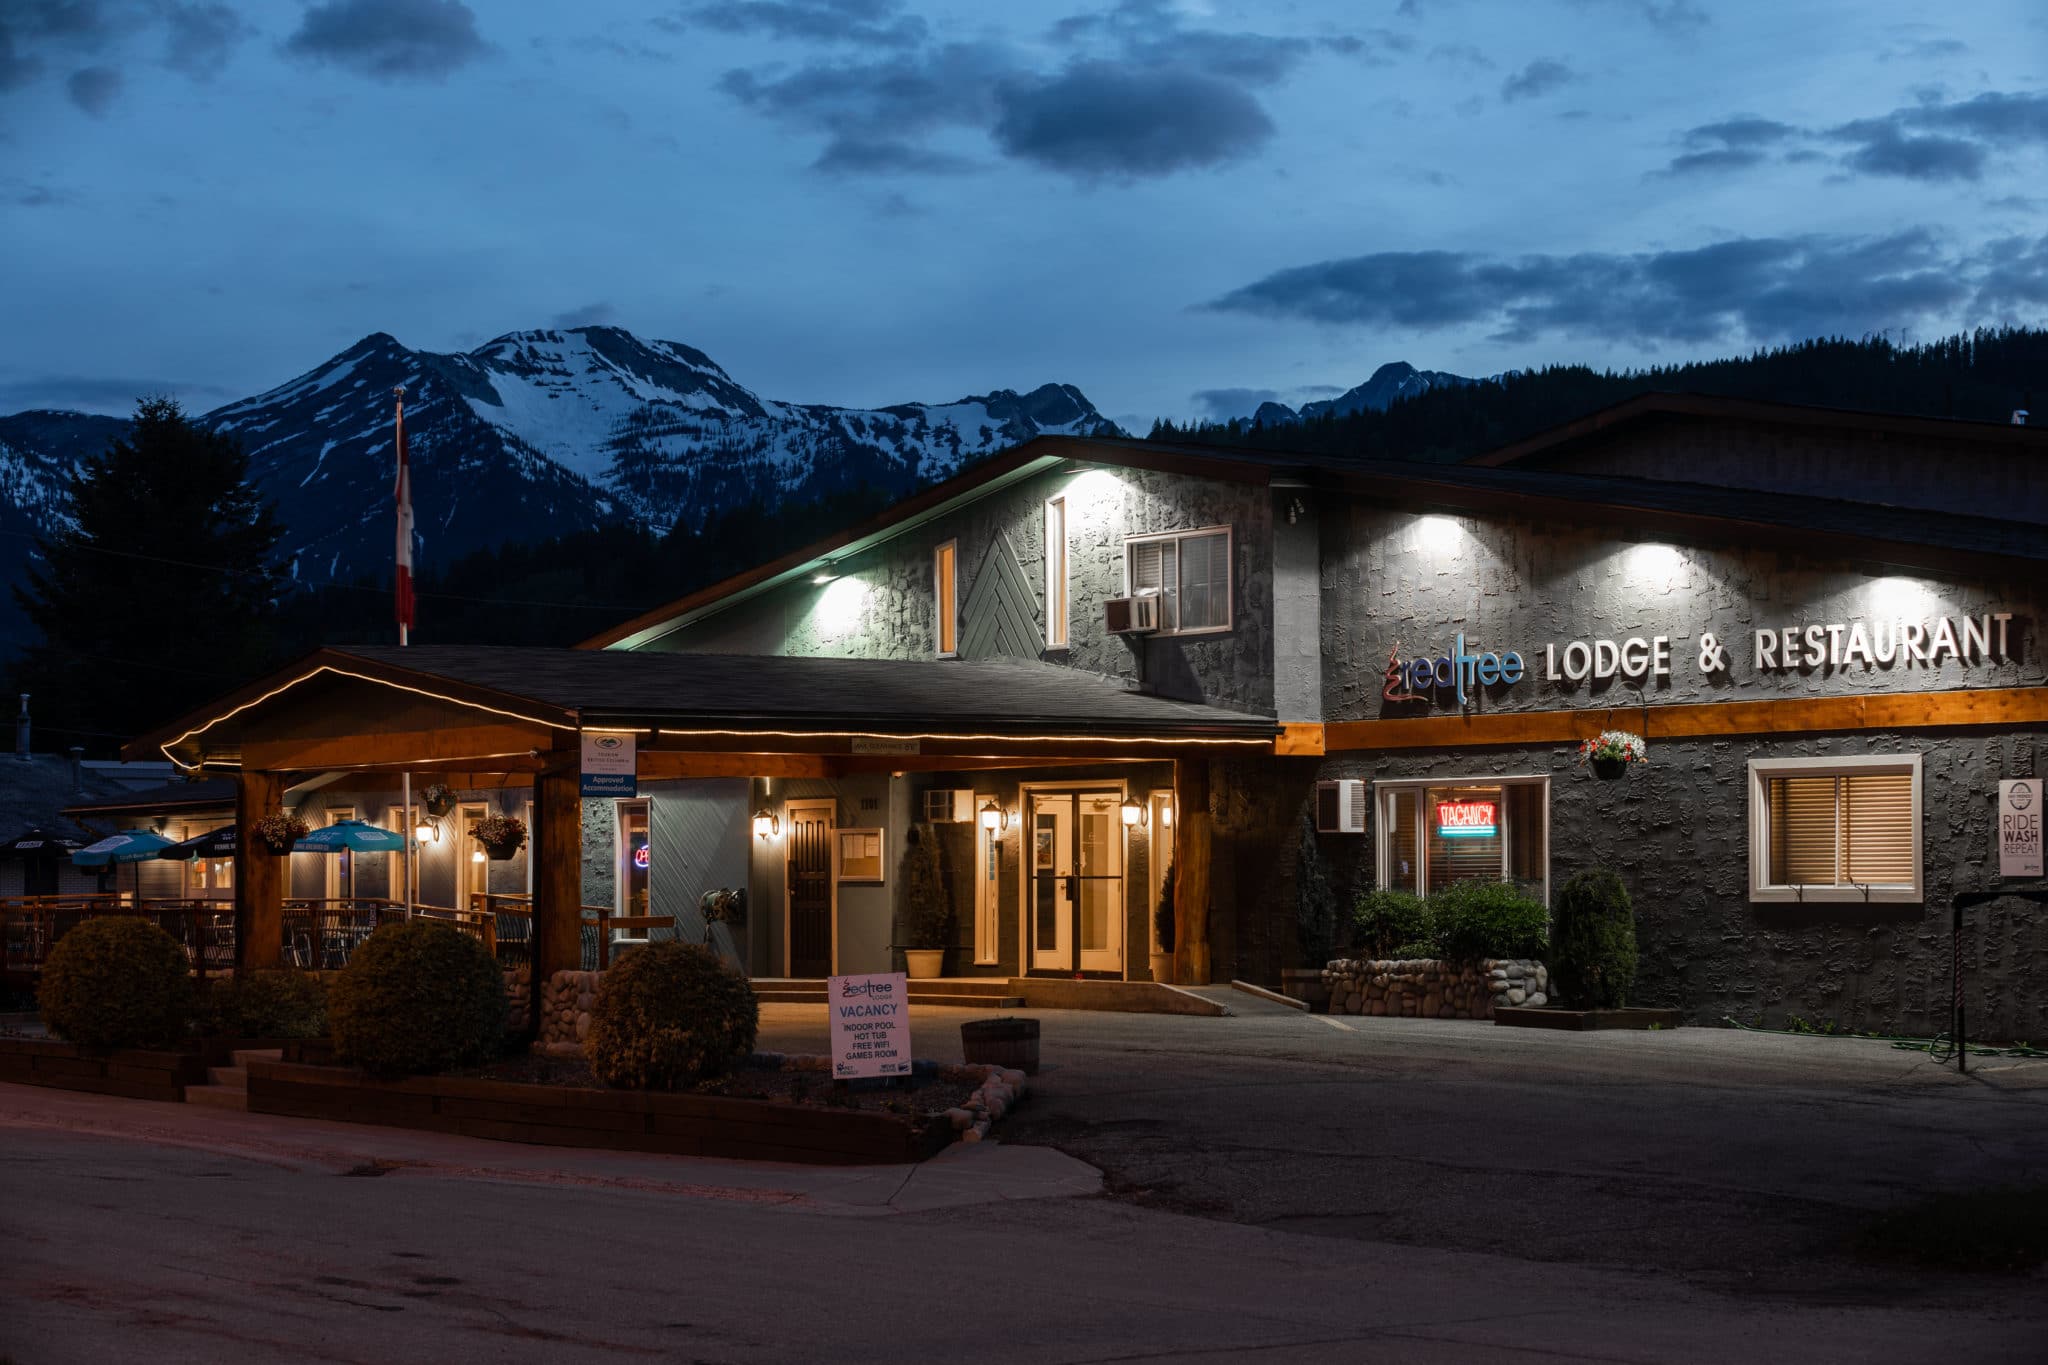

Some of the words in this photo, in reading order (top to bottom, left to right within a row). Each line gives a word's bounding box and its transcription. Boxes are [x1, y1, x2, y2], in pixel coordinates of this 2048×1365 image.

[1400, 633, 1525, 705] redtree
[1546, 635, 1671, 681] LODGE
[1698, 632, 1726, 673] &
[1755, 612, 2013, 669] RESTAURANT
[592, 776, 625, 785] Approved
[583, 784, 634, 793] Accommodation
[1440, 805, 1494, 826] VACANCY
[2003, 814, 2038, 830] RIDE
[2004, 830, 2039, 842] WASH
[2003, 843, 2038, 854] REPEAT
[840, 1003, 898, 1018] VACANCY
[843, 1022, 873, 1032] INDOOR
[875, 1021, 896, 1030] POOL
[854, 1032, 870, 1040] HOT
[872, 1031, 887, 1039] TUB
[852, 1041, 872, 1050] FREE
[874, 1041, 890, 1049] WIFI
[846, 1051, 873, 1060] GAMES
[875, 1050, 897, 1058] ROOM
